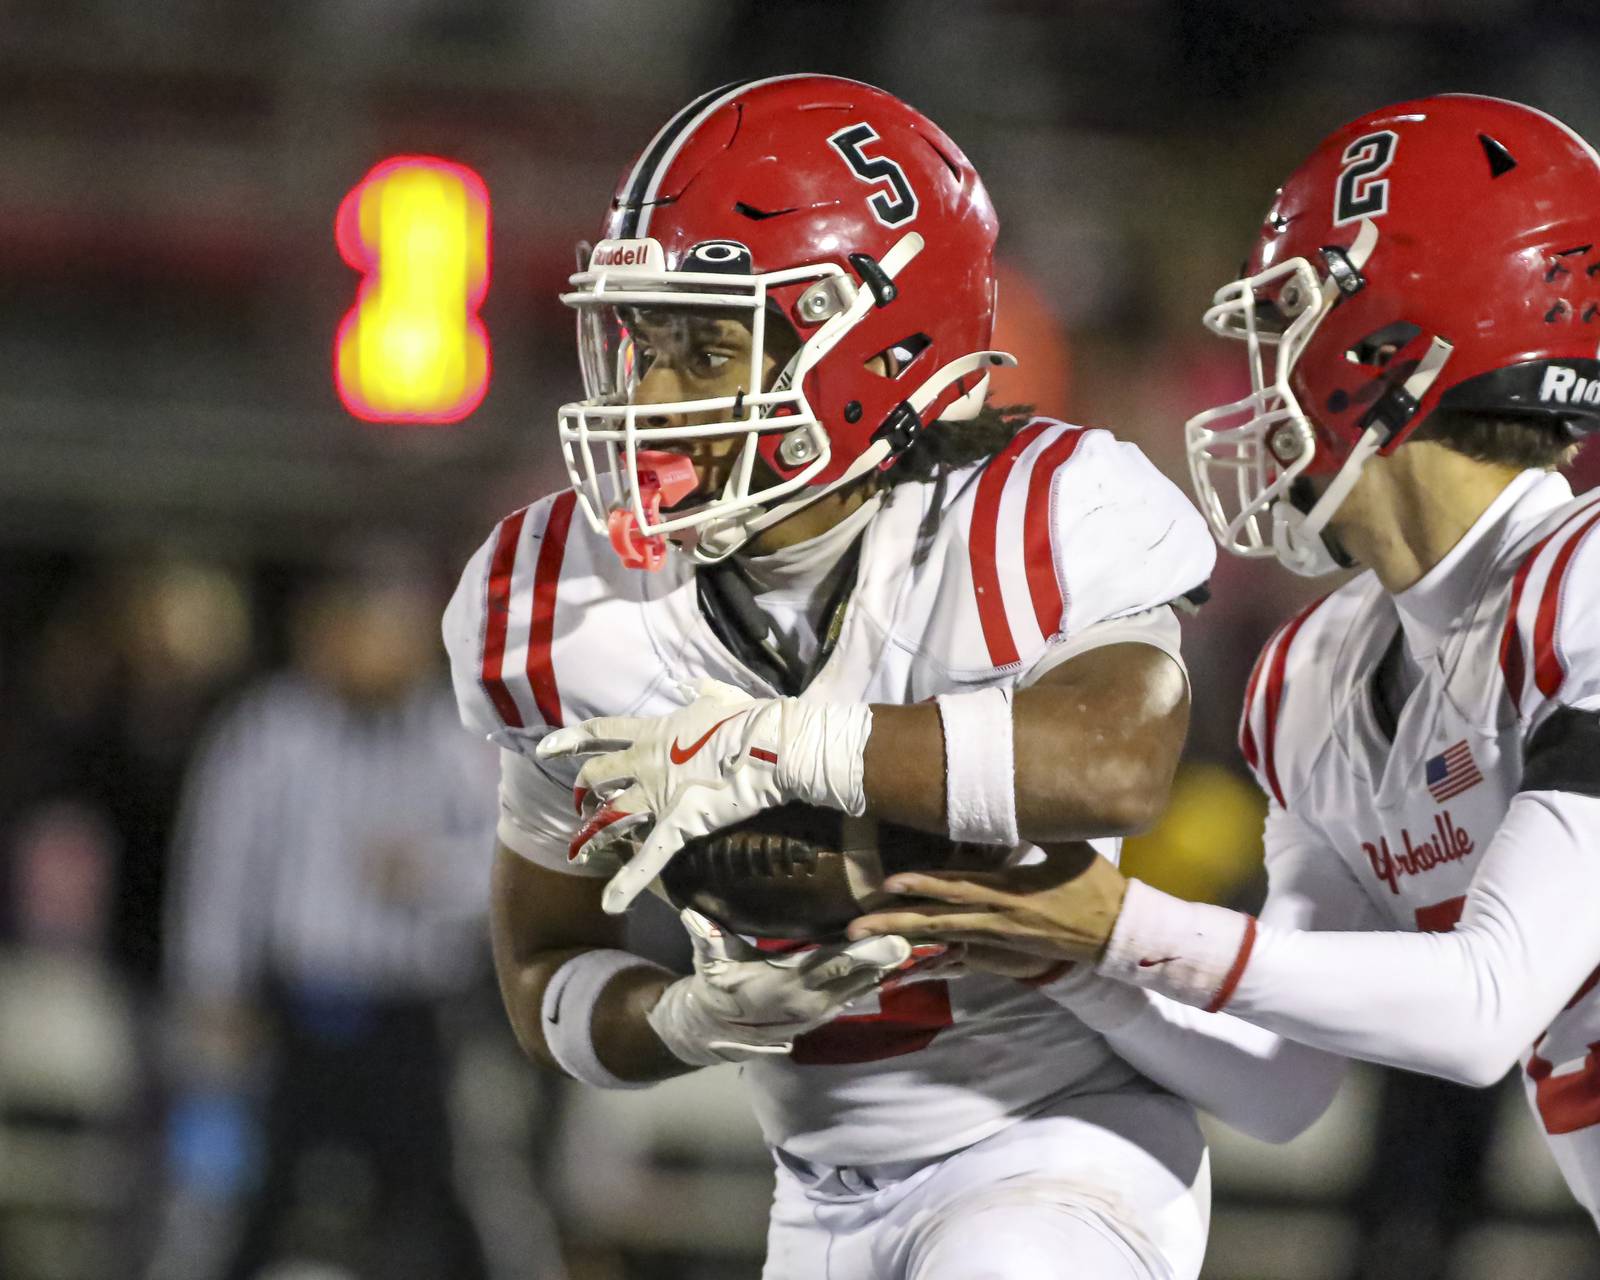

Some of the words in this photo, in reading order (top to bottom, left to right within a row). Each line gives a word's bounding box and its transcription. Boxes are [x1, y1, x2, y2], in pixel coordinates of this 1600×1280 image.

[826, 121, 919, 229] 5
[1332, 129, 1399, 228] 2
[1361, 810, 1475, 895] Yrkville
